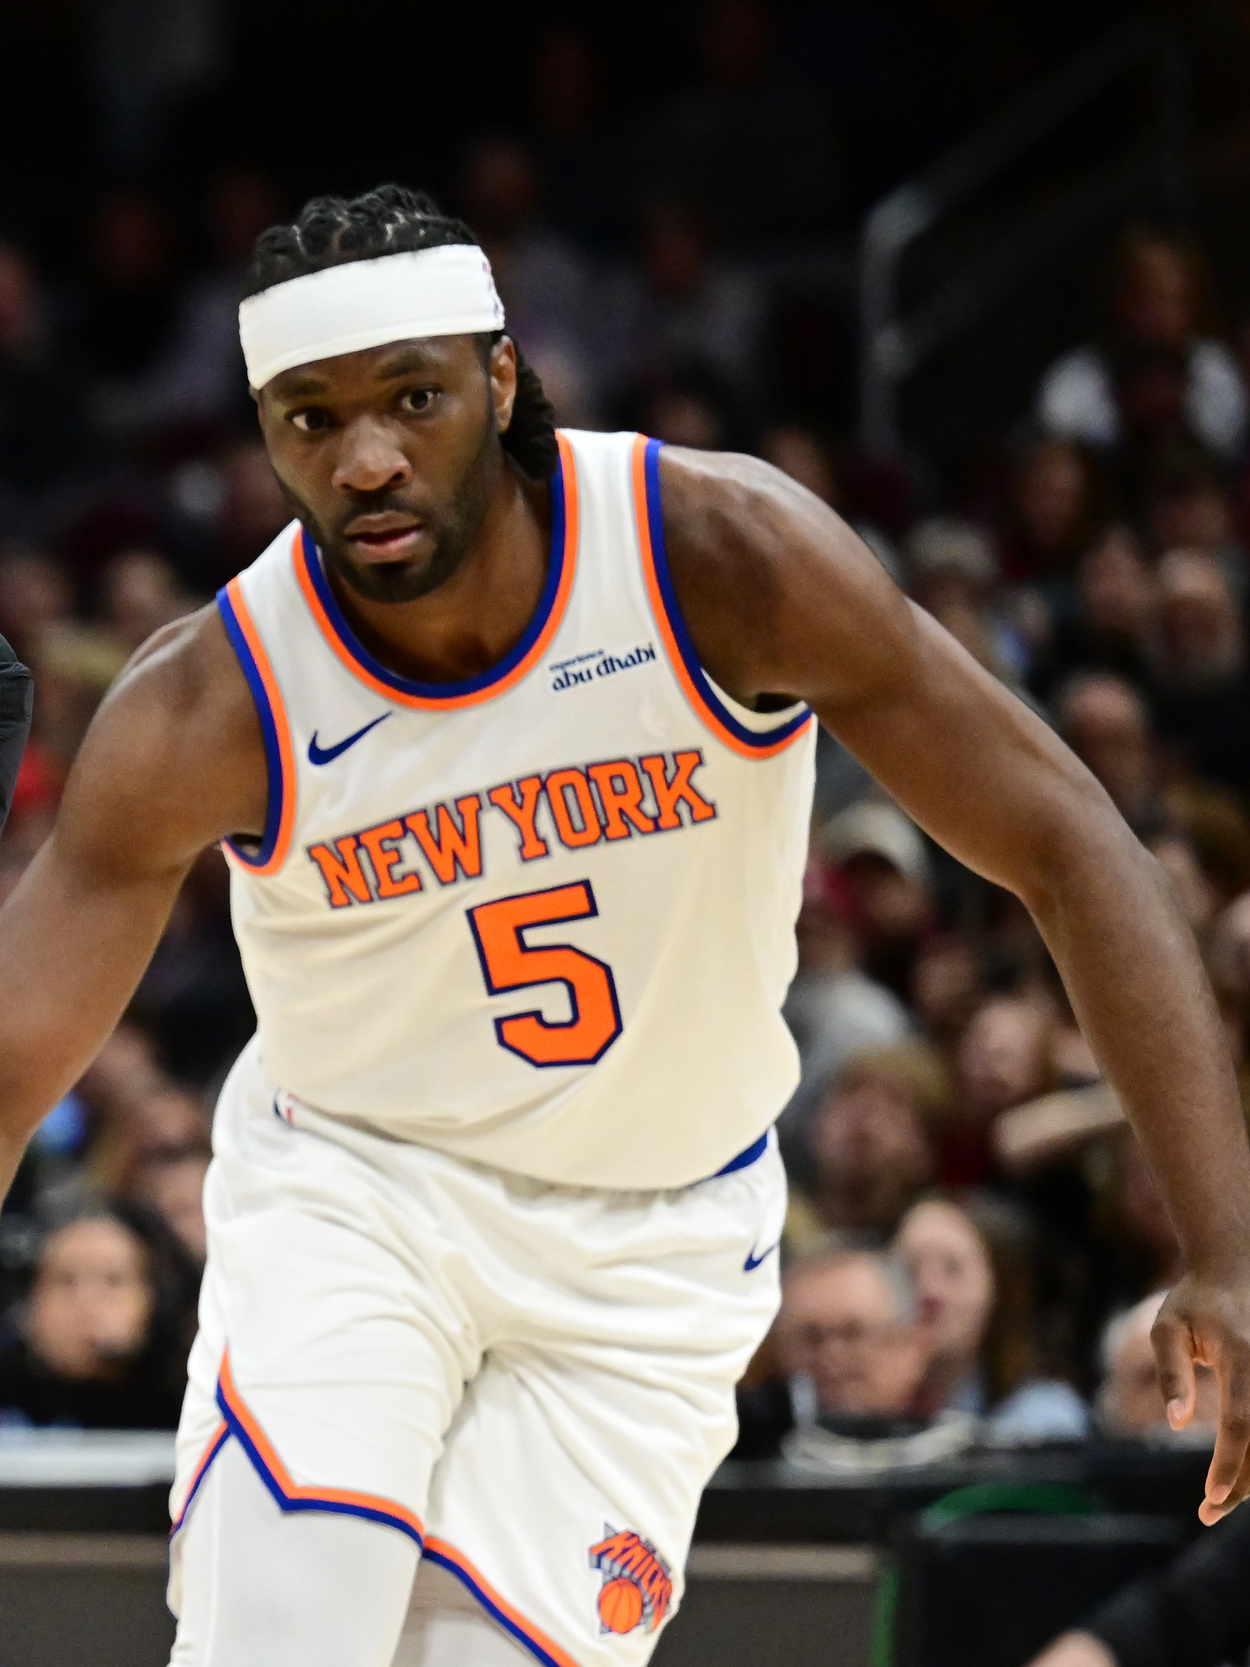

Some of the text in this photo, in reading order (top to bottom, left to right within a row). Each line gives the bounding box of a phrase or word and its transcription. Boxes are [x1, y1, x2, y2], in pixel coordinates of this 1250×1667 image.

[553, 642, 656, 691] abu dhabi
[306, 748, 719, 910] NEW YORK
[465, 879, 624, 1068] 5
